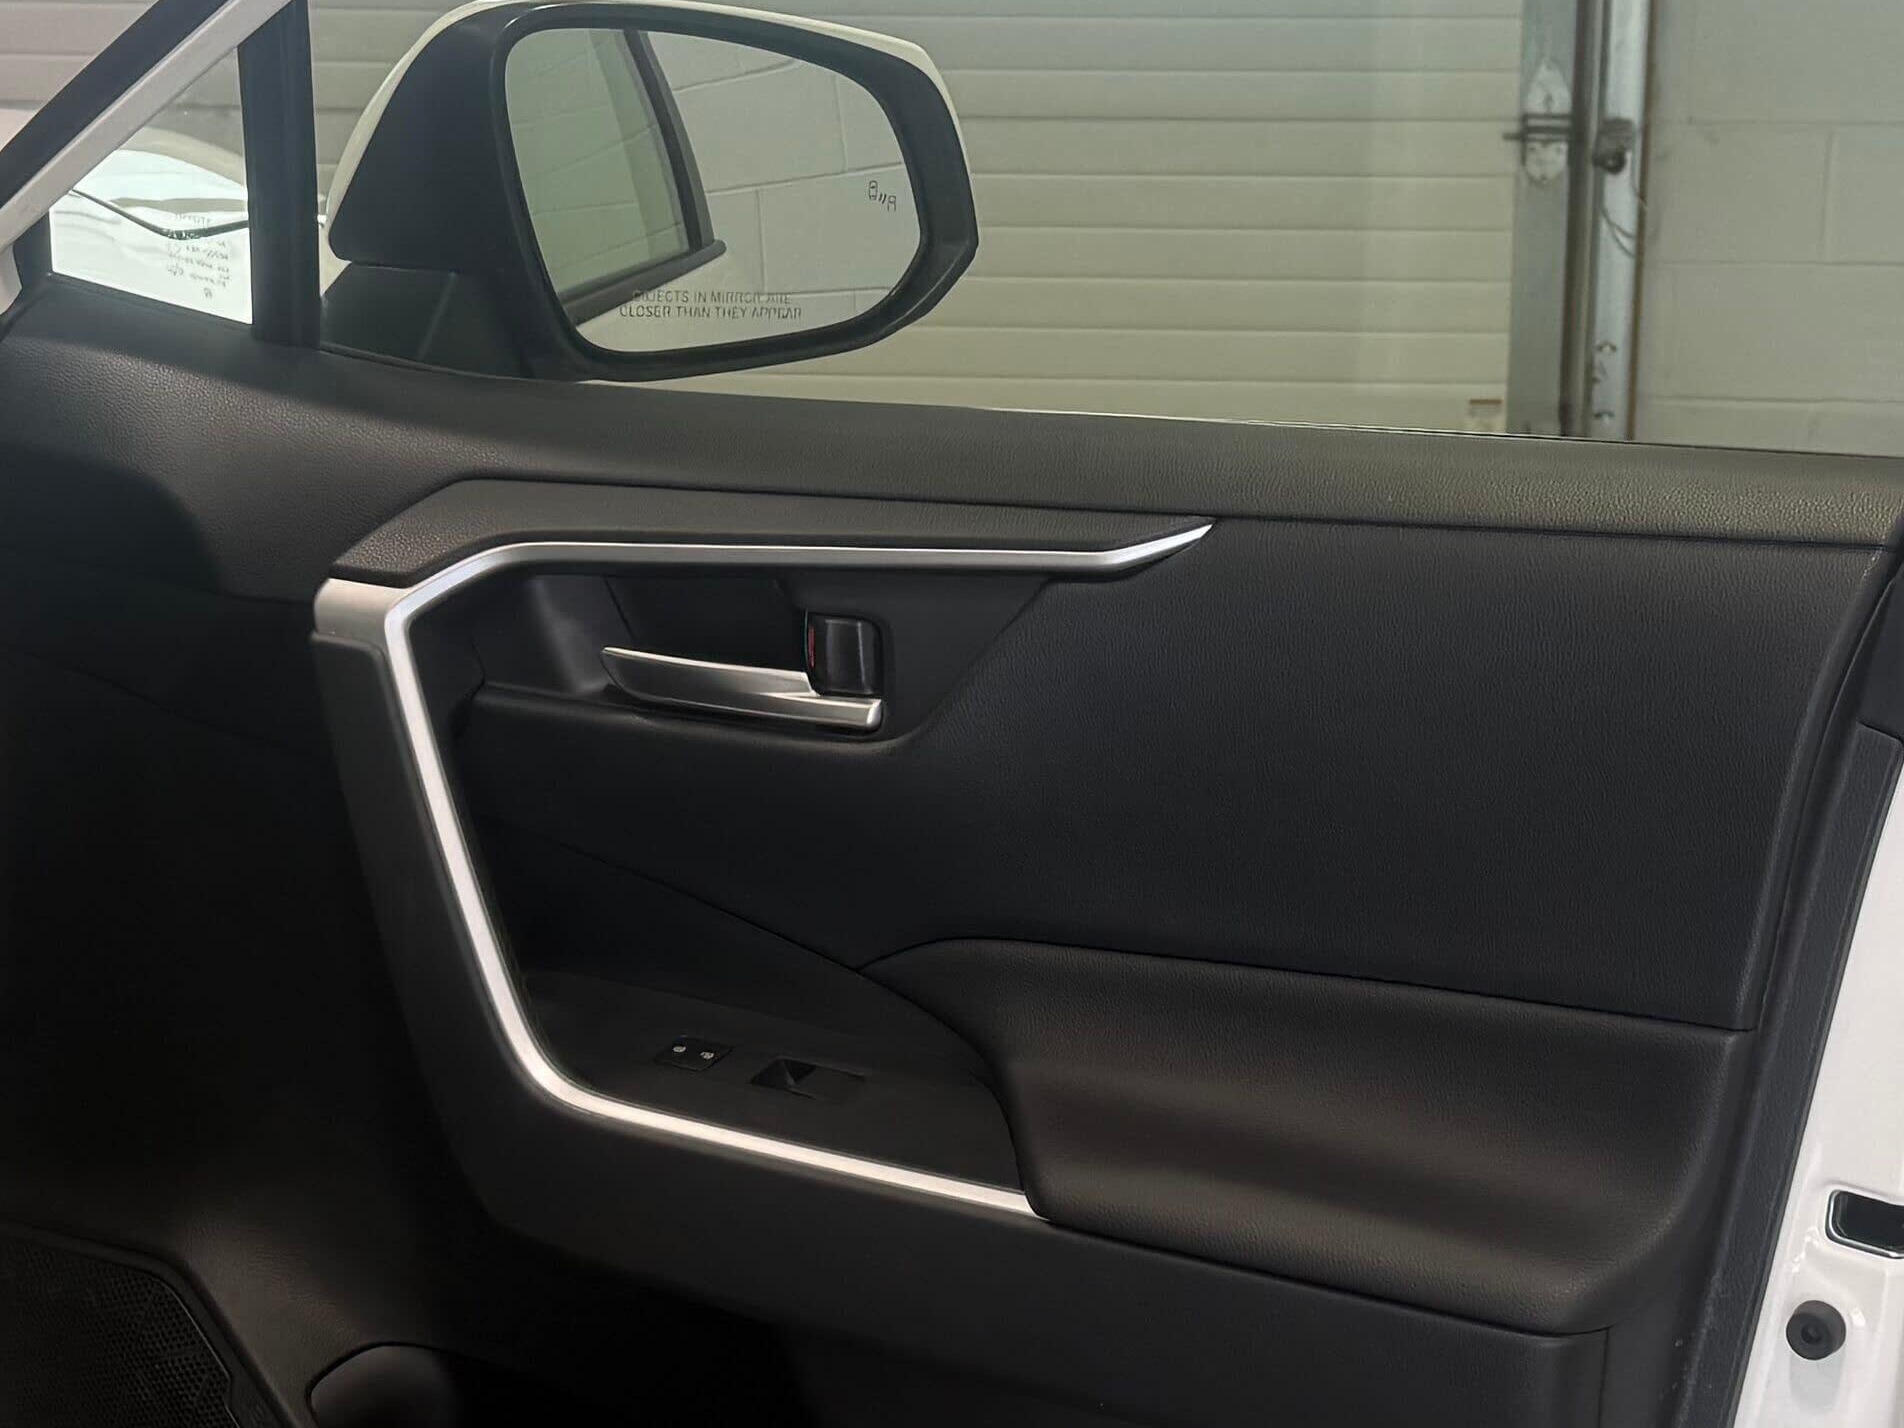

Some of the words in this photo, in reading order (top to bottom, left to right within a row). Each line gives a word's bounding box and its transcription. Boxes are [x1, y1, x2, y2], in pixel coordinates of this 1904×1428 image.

[694, 291, 707, 303] IN
[619, 304, 671, 318] CLOSER
[676, 305, 710, 319] THAN
[715, 306, 747, 320] THEY
[751, 306, 802, 320] APPEAR
